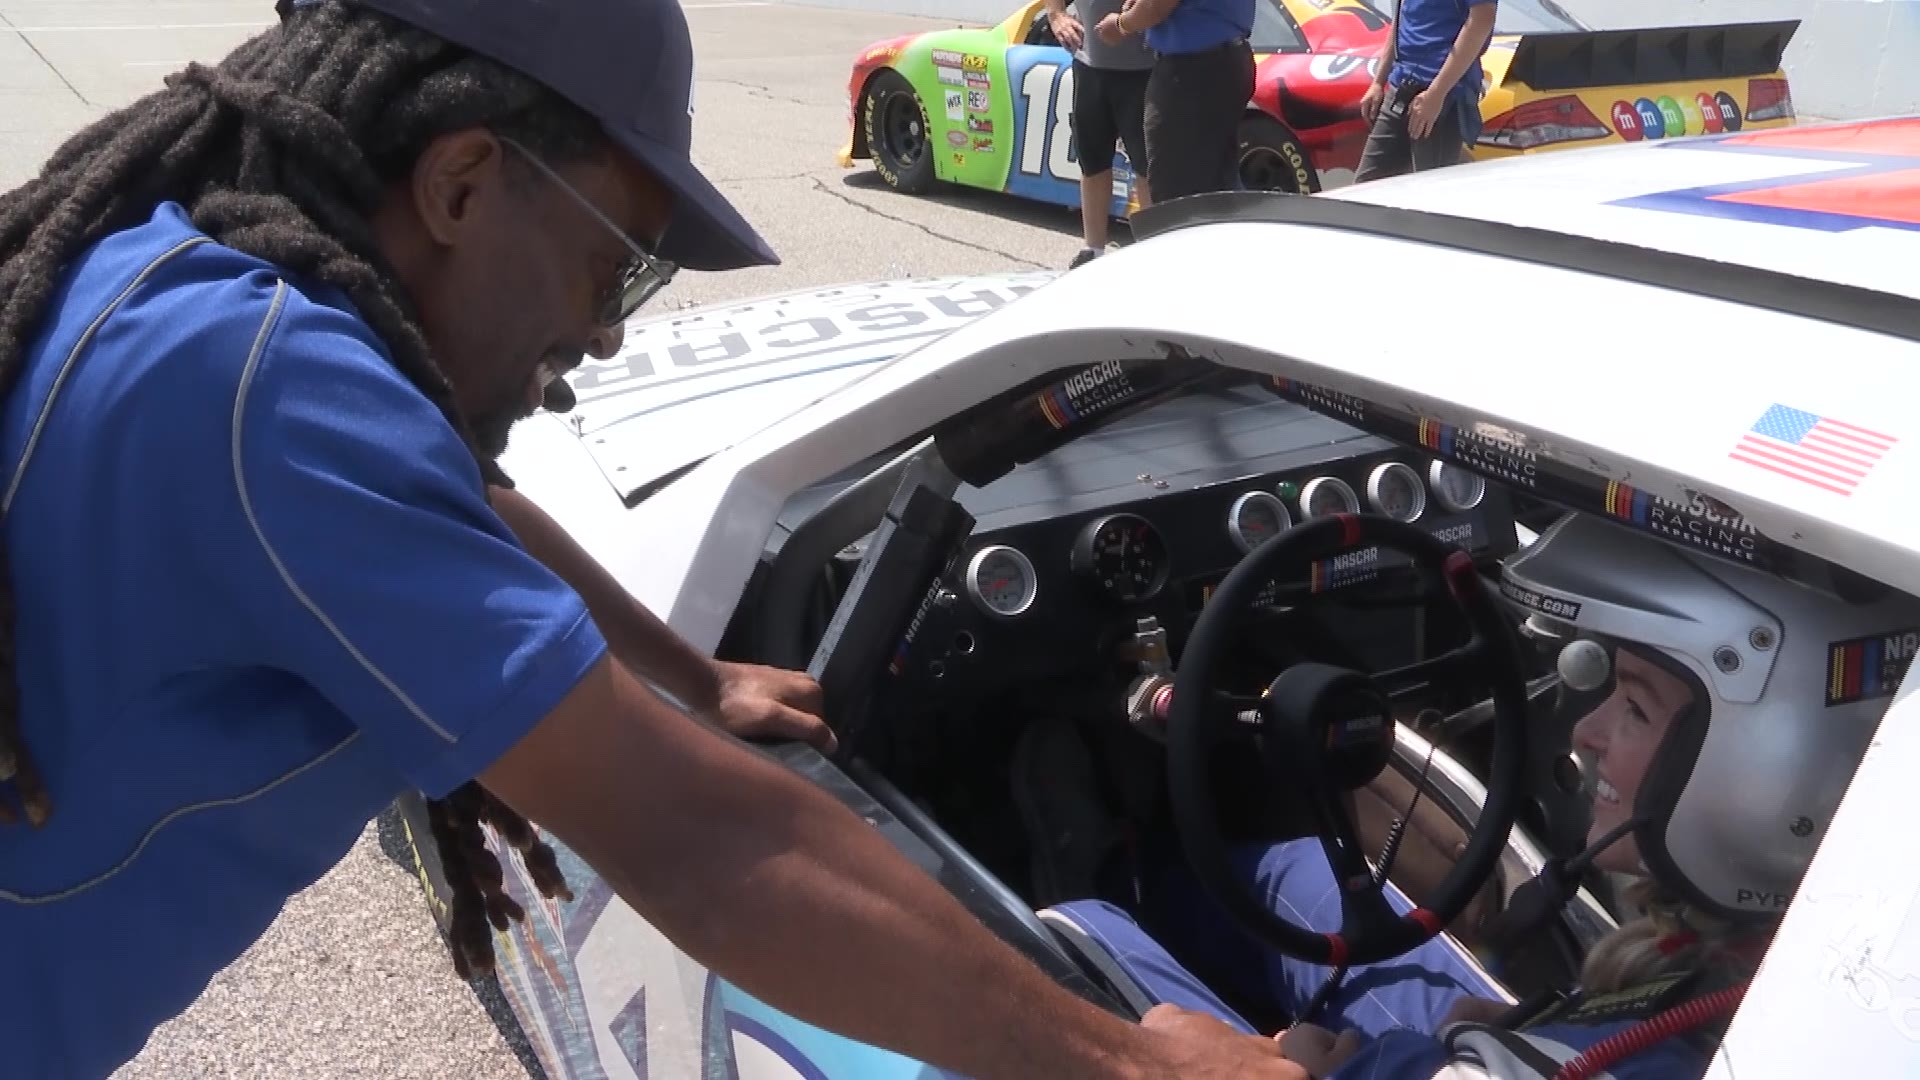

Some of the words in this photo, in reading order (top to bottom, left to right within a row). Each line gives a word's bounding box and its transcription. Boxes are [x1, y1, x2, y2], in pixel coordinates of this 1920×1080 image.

[1064, 359, 1122, 400] NASCAR
[1455, 438, 1536, 477] RACING
[1651, 506, 1754, 550] RACING
[1651, 520, 1753, 561] EXPERIENCE
[1333, 546, 1378, 572] NASCAR
